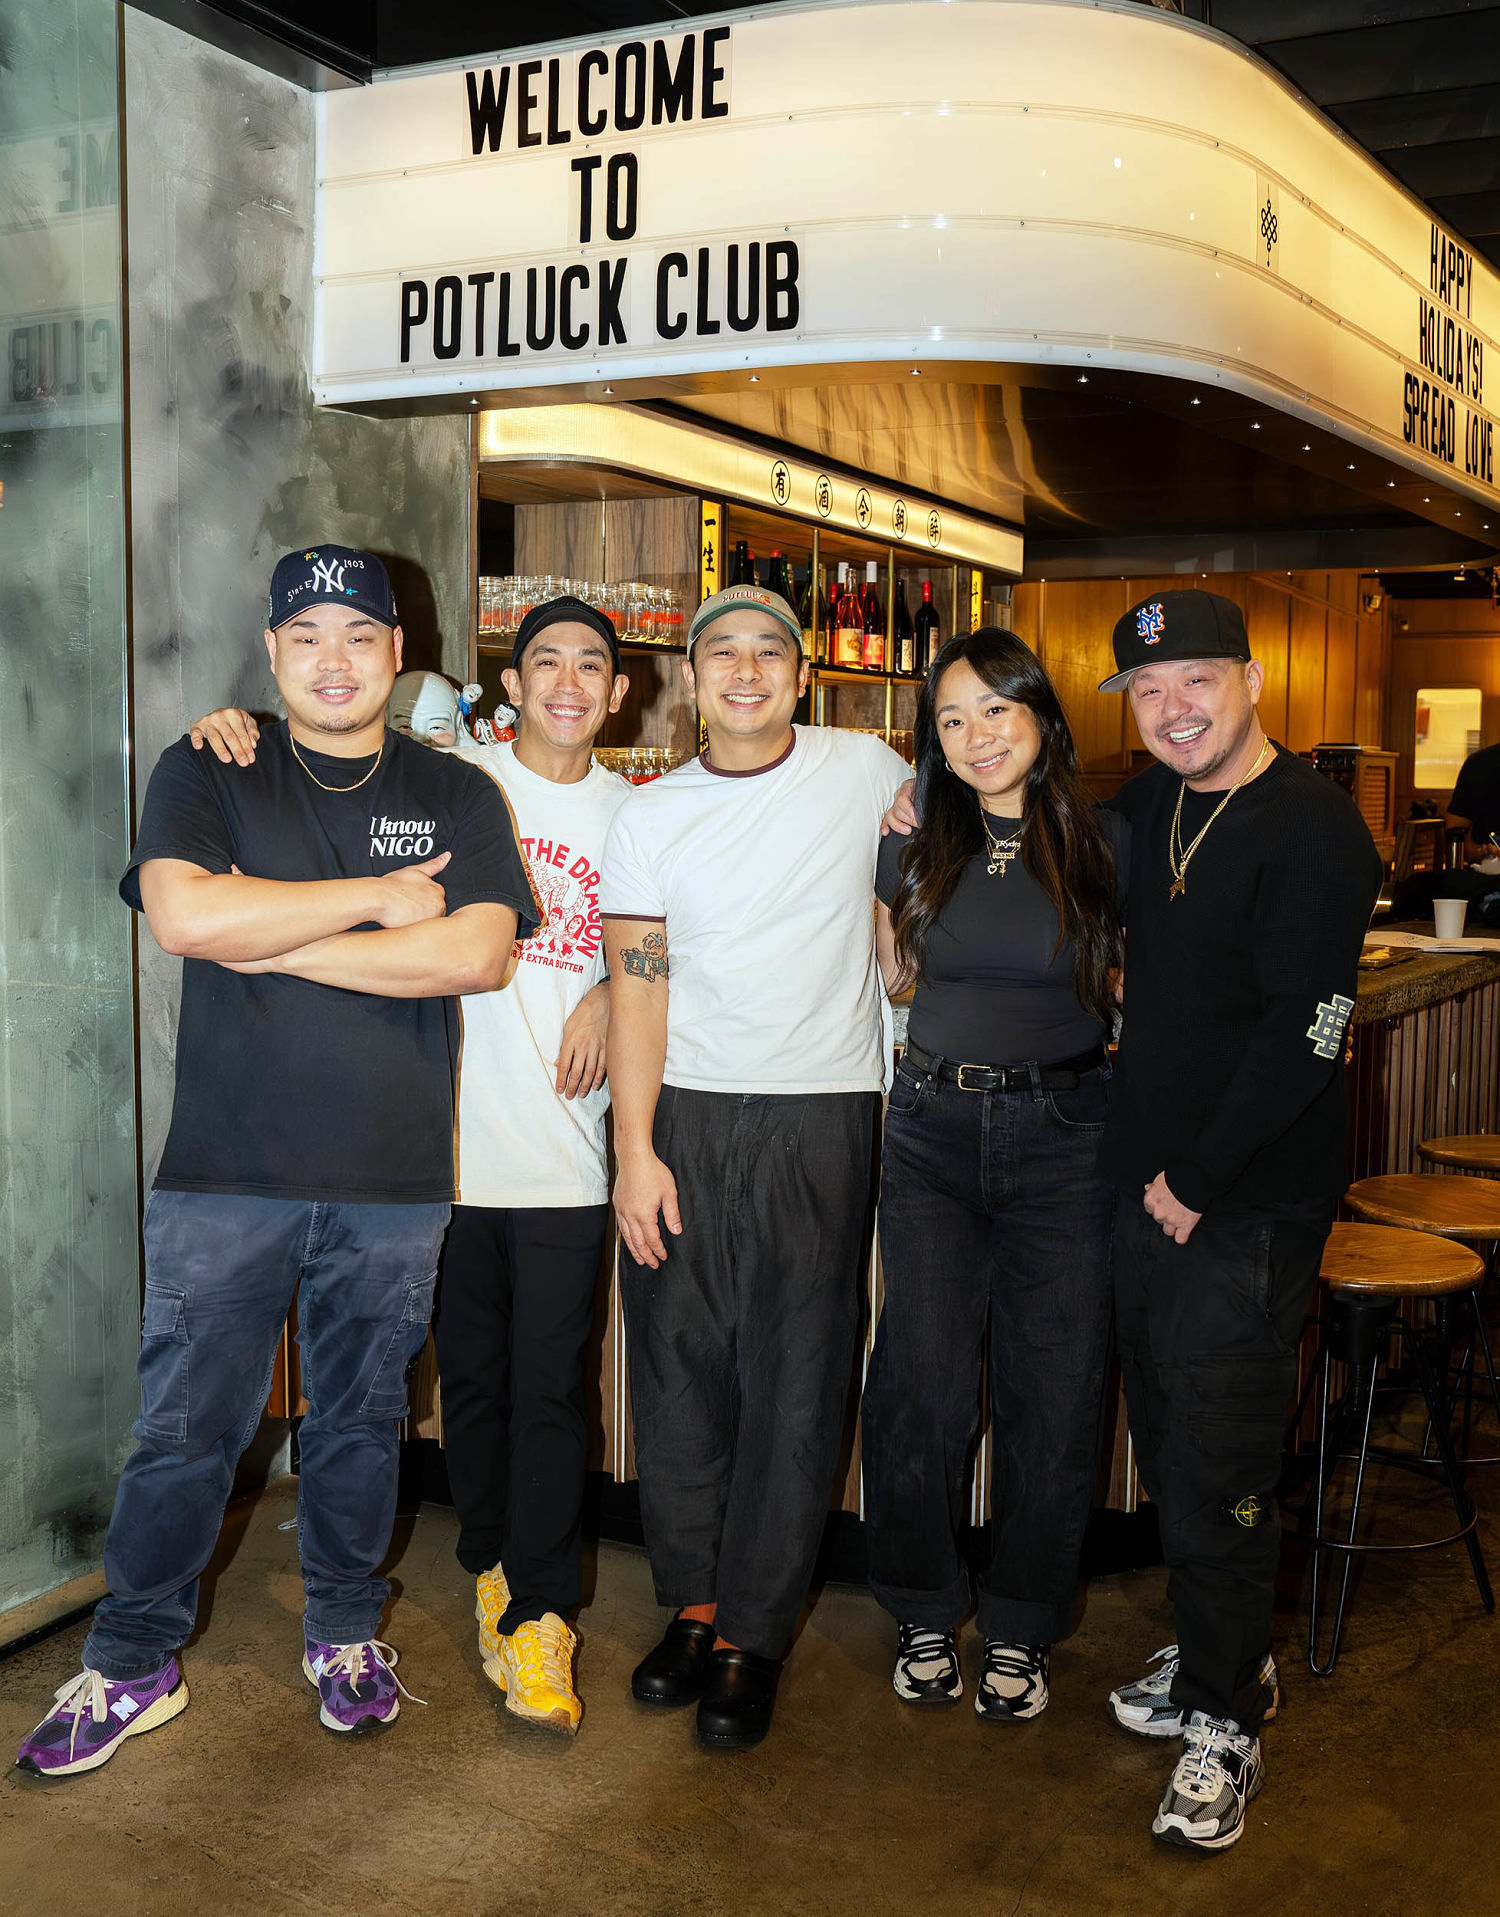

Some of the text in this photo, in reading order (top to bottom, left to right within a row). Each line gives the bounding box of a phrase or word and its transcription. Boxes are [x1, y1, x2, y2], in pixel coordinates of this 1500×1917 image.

[465, 25, 731, 155] WELCOME
[570, 152, 638, 243] TO
[400, 240, 800, 363] POTLUCK CLUB
[1430, 223, 1473, 319] HAPPY
[1419, 296, 1483, 405] HOLIDAYS!
[1403, 371, 1493, 484] SPREAD LOVE
[311, 558, 345, 593] NY
[344, 559, 365, 569] 1903
[369, 815, 436, 836] I know
[369, 836, 434, 857] NIGO
[520, 838, 603, 960] THE DRAGON
[525, 952, 555, 967] EXTRA
[555, 958, 585, 974] BUTTER
[110, 1692, 140, 1722] N
